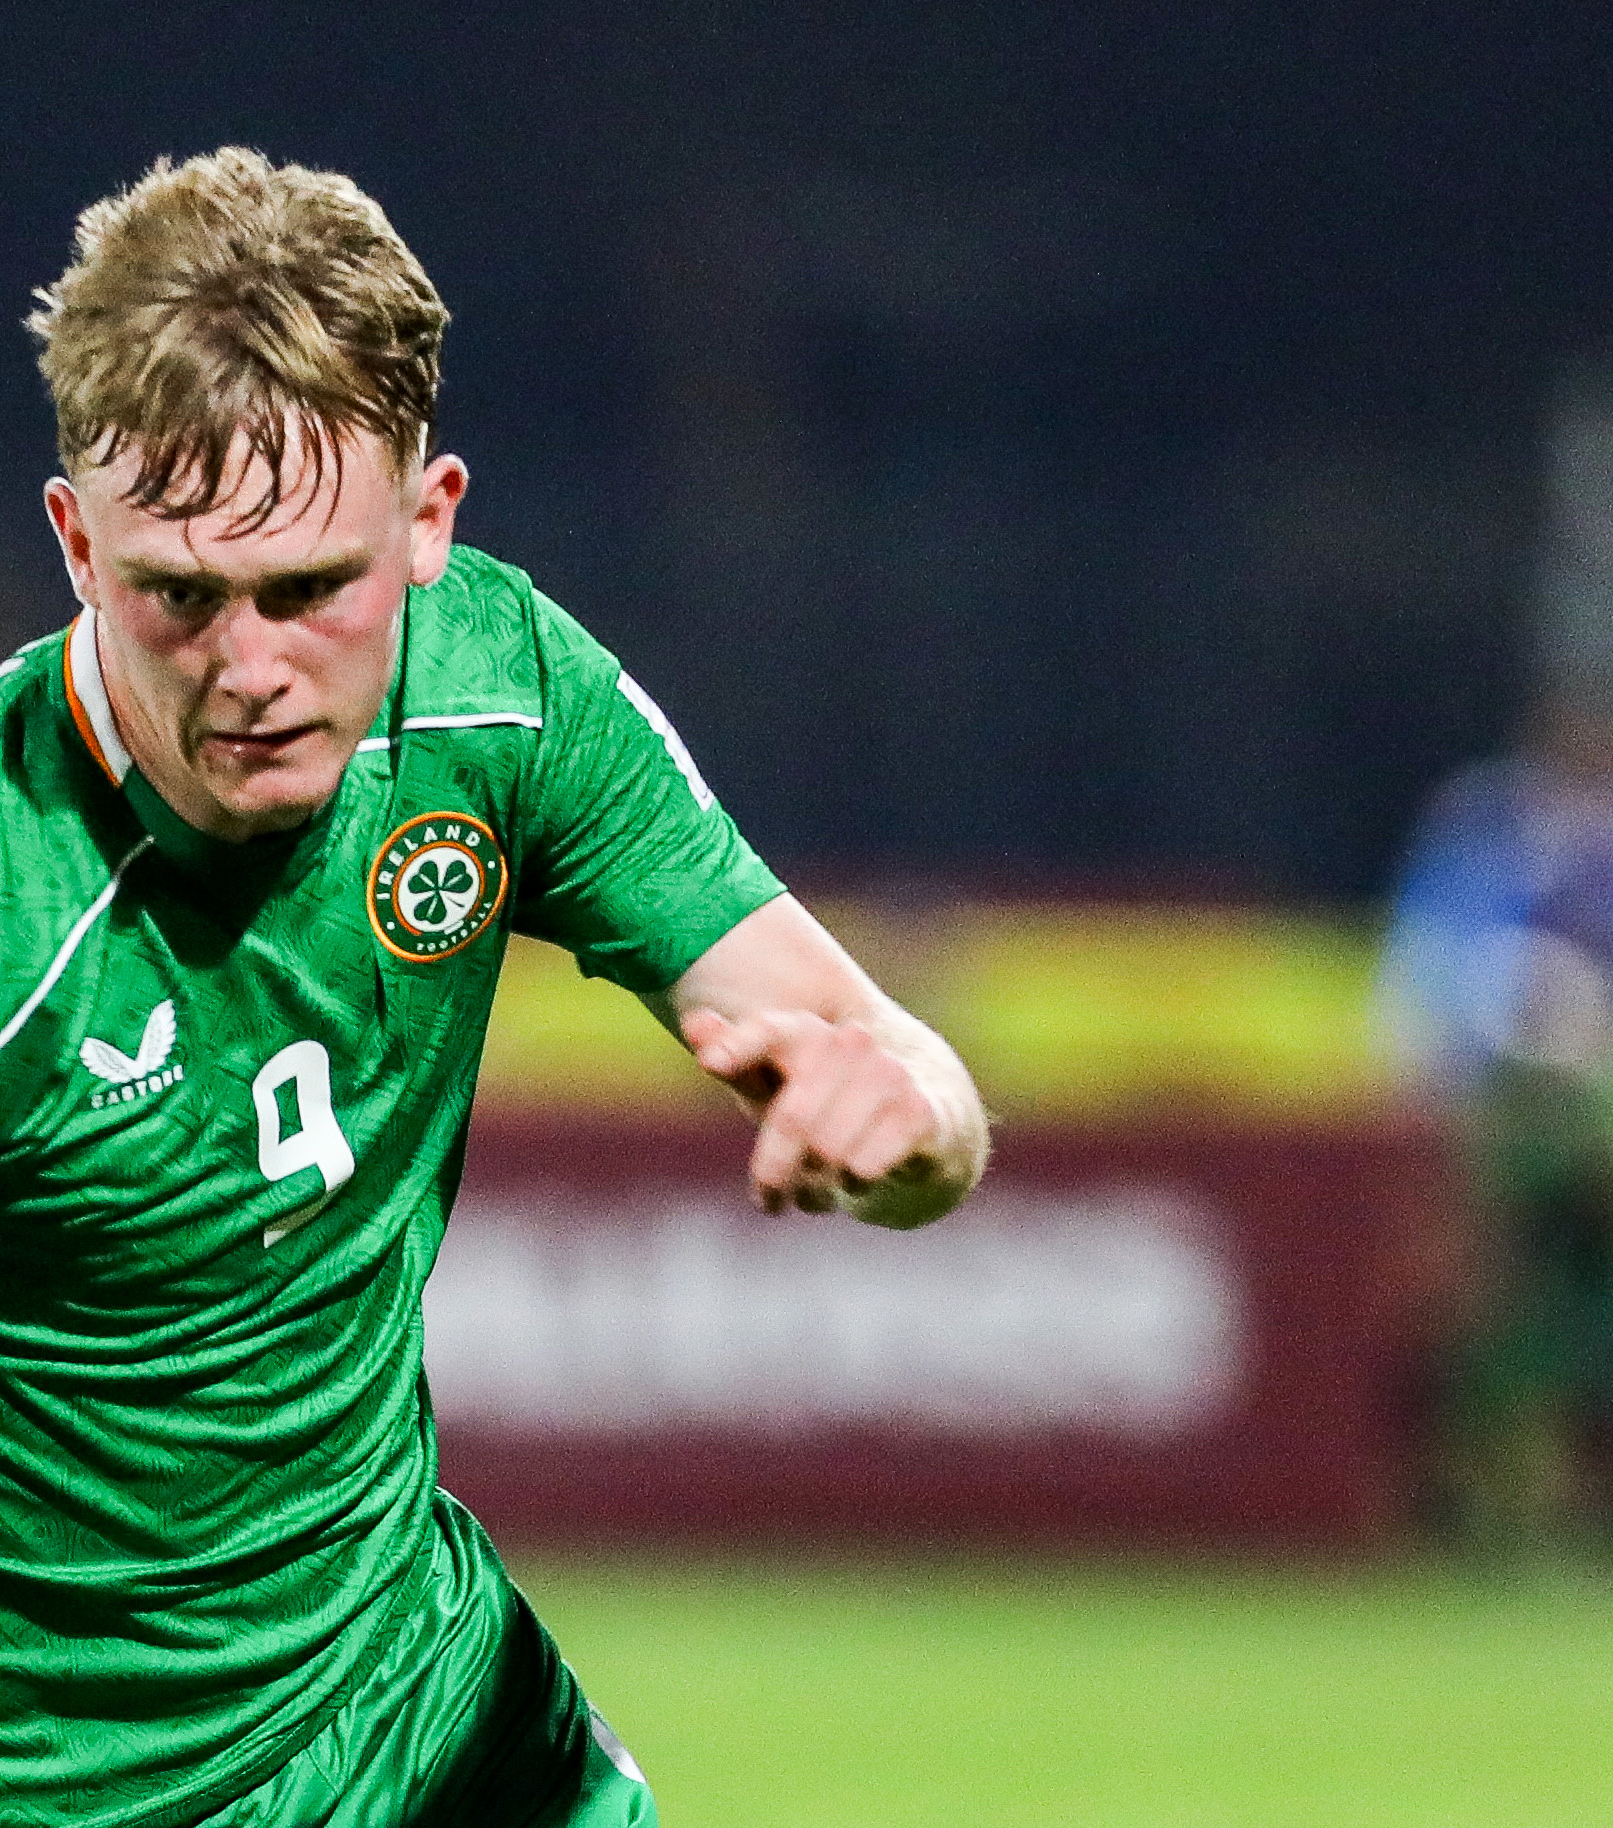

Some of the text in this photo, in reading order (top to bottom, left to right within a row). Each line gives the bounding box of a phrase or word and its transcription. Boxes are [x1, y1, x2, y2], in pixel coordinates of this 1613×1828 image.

[376, 824, 481, 900] IRELAND
[416, 902, 493, 952] FOOTBALL
[91, 1064, 184, 1110] CASTORE
[253, 1039, 355, 1250] 9
